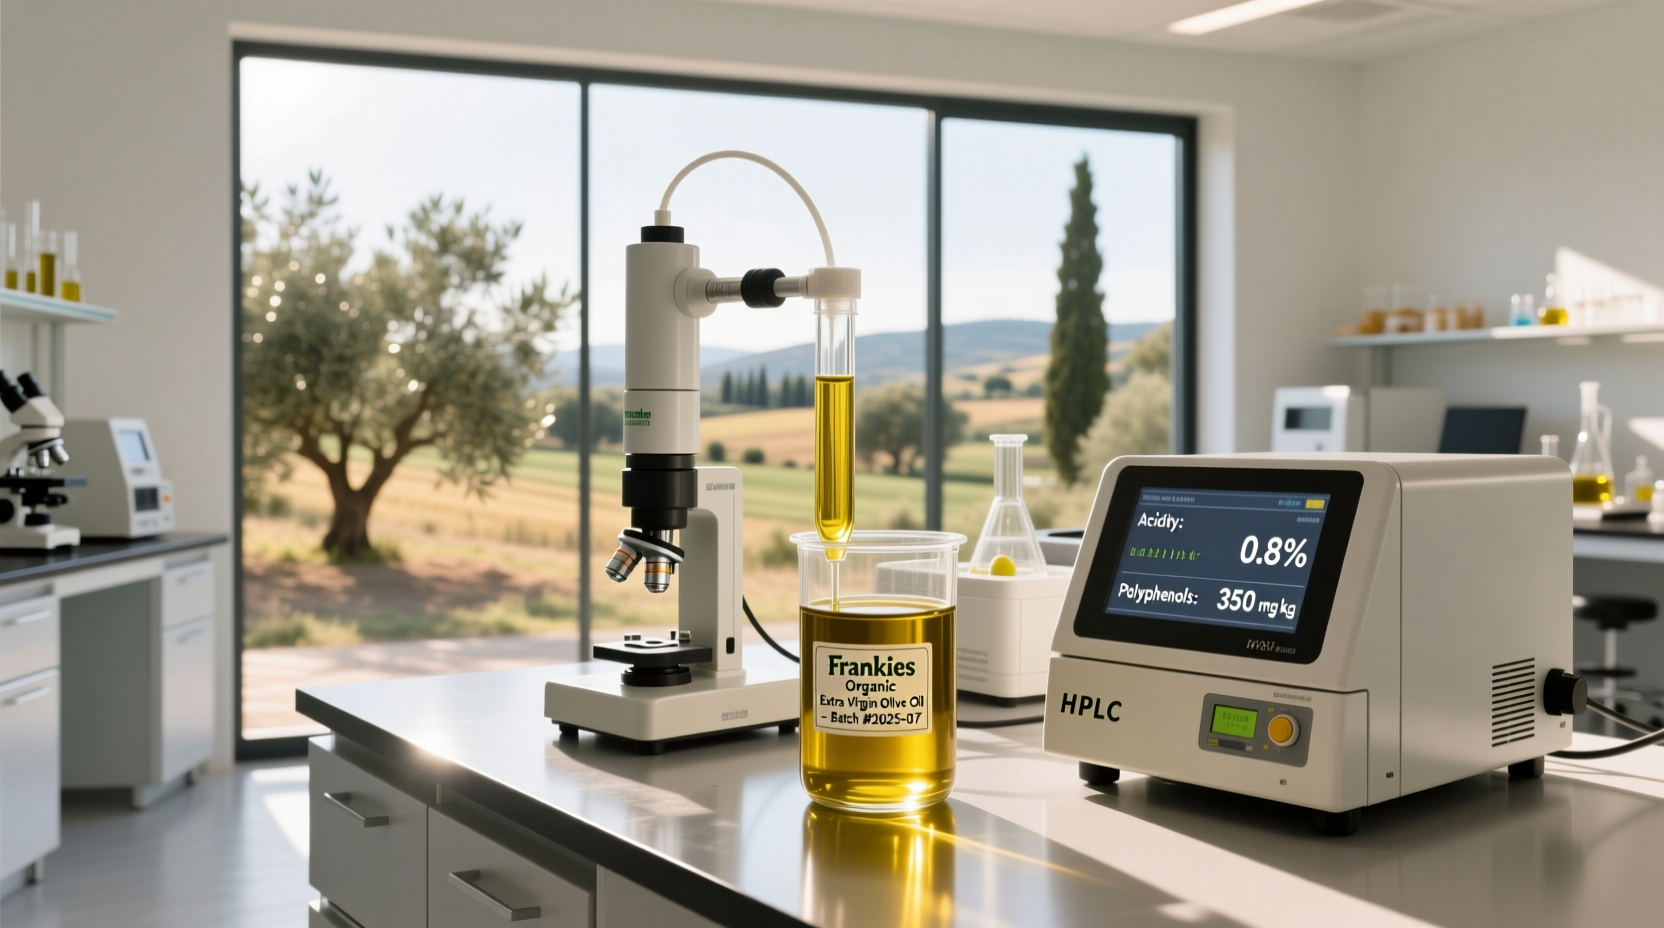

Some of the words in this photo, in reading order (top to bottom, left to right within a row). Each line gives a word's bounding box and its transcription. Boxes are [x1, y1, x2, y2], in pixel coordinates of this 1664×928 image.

[1137, 511, 1185, 533] Acidity:
[1239, 534, 1308, 568] 0.8%
[1117, 582, 1199, 605] Polyphenols:
[1216, 587, 1257, 612] 350
[828, 654, 916, 677] Frankies
[845, 679, 897, 697] Organic
[819, 694, 845, 708] Extra
[1060, 692, 1123, 723] HPLC
[830, 711, 859, 725] Batch
[862, 711, 923, 726] #2025-07
